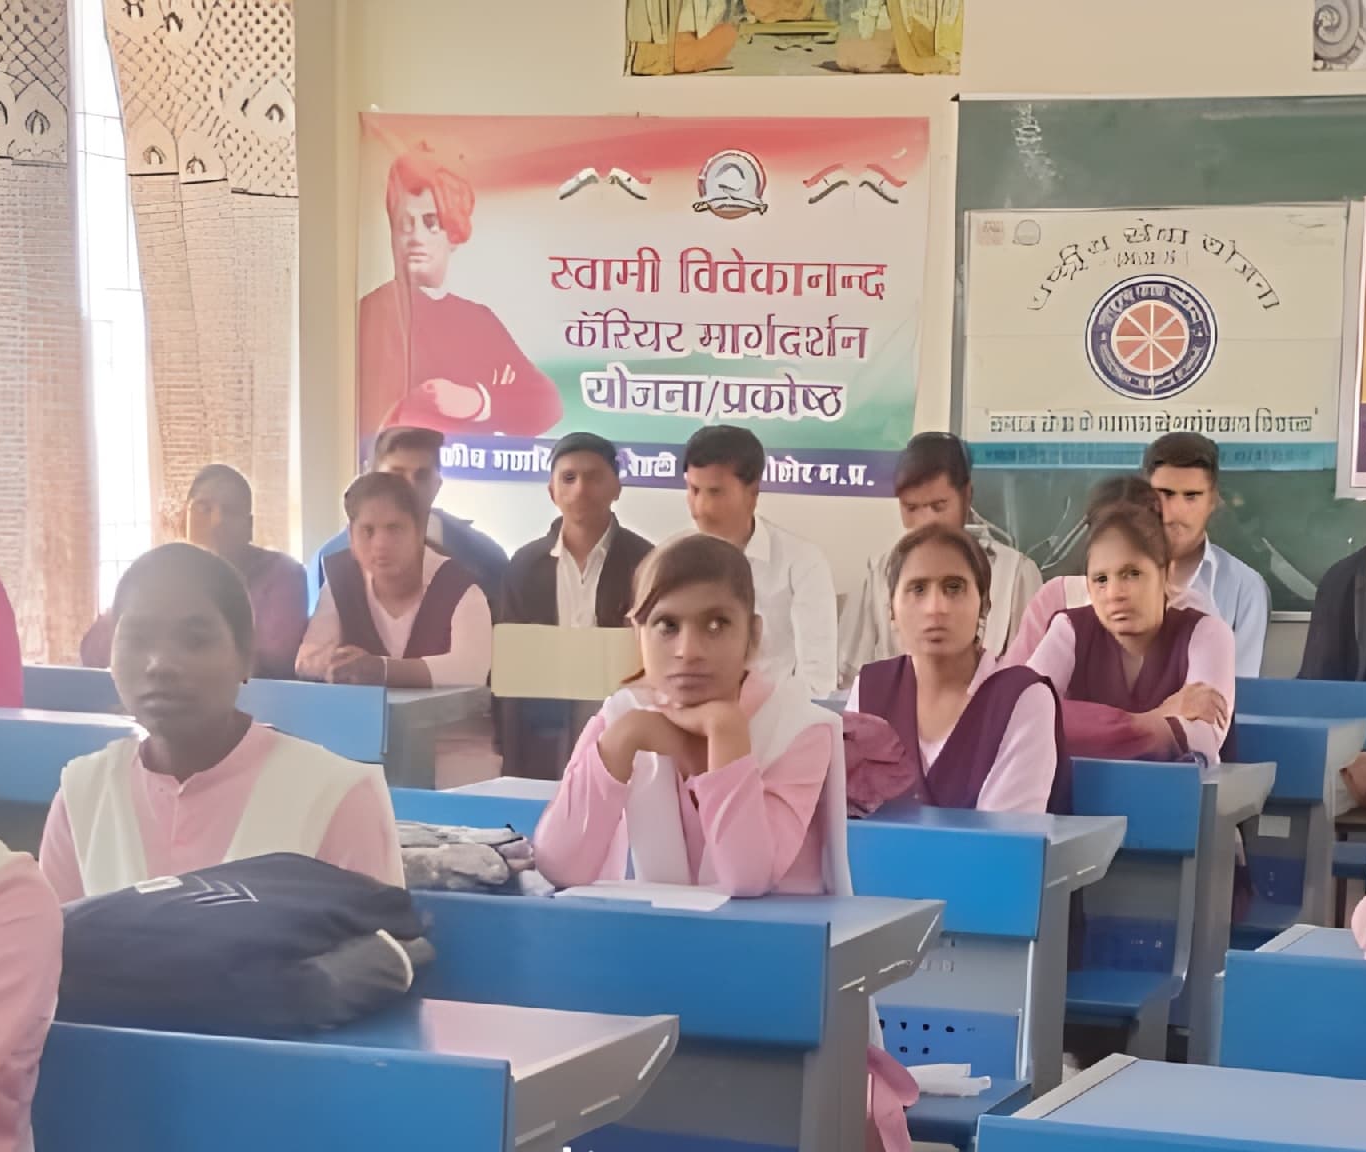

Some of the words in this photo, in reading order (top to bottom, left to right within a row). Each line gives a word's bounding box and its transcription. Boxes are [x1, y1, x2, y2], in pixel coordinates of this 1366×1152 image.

[548, 247, 661, 293] स्वामी
[679, 247, 888, 300] विवेकानन्द
[695, 313, 870, 359] मार्गदर्शन
